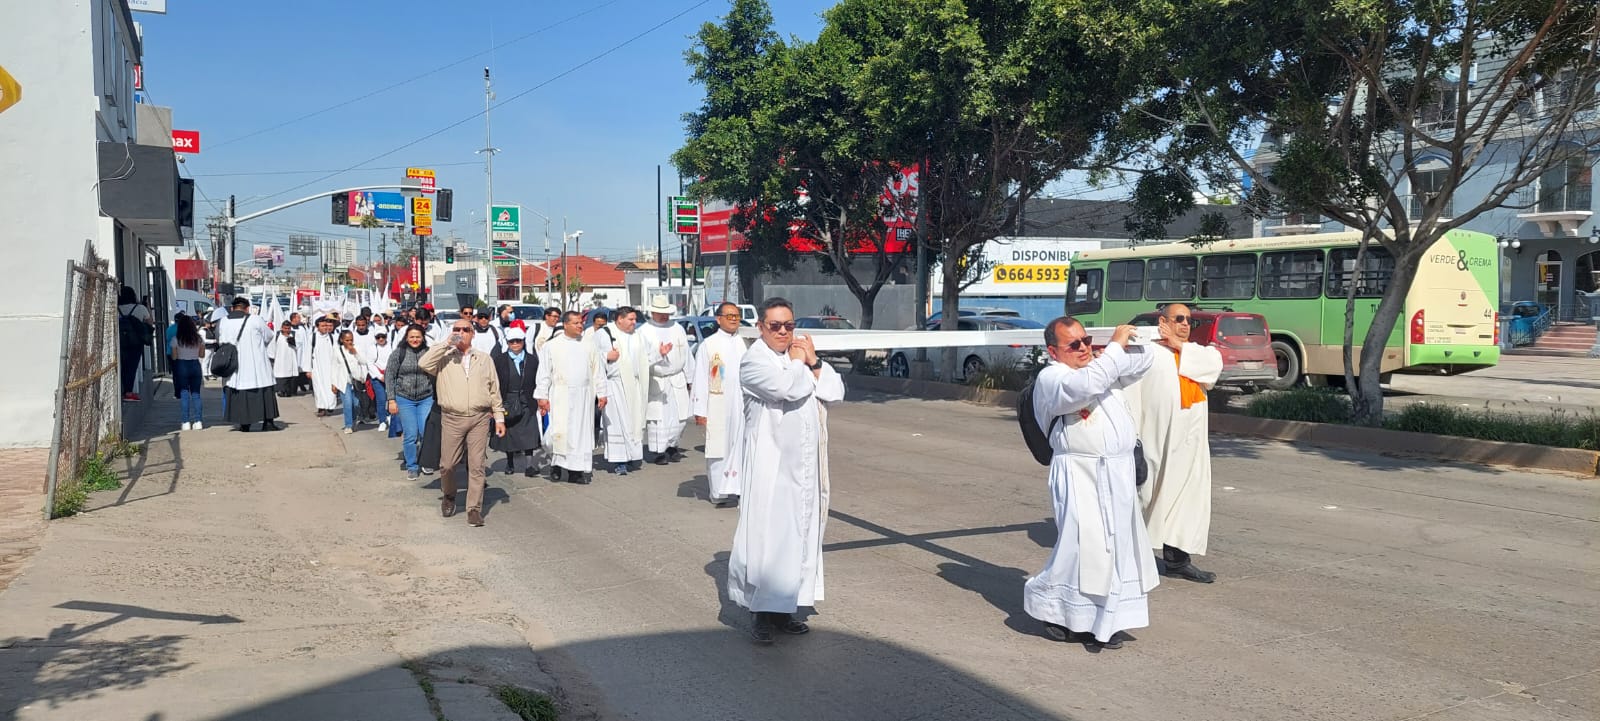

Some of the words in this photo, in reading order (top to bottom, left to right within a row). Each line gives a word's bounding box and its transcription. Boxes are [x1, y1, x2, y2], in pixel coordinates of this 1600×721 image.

[416, 201, 430, 210] 24
[1012, 250, 1080, 262] DISPONIBL
[1430, 254, 1456, 265] VERDE
[1456, 249, 1469, 271] &
[1469, 256, 1492, 267] CREMA
[1009, 268, 1033, 281] 664
[1036, 268, 1060, 281] 593
[1484, 308, 1492, 319] 44
